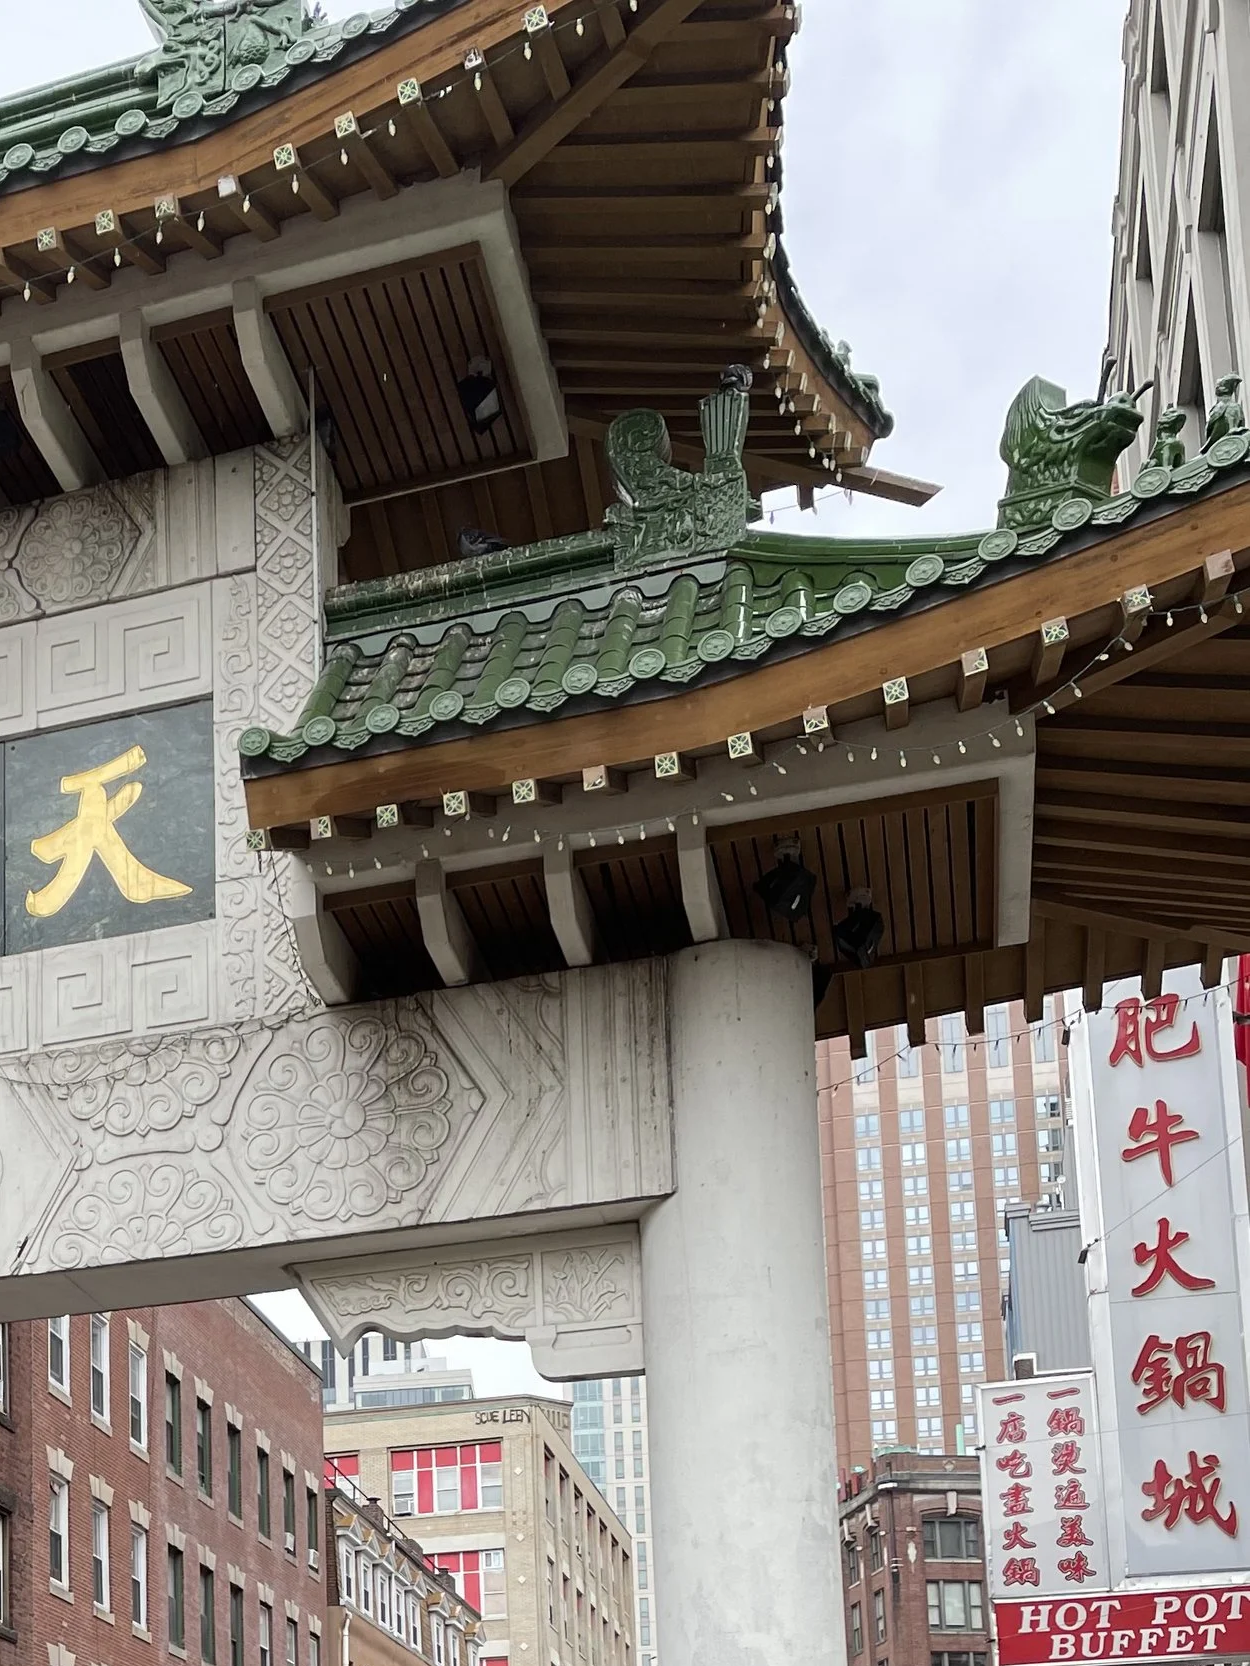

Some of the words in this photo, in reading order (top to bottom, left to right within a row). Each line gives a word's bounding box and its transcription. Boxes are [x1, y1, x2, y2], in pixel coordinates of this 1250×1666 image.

[1109, 993, 1238, 1540] 肥牛火鍋城
[992, 1392, 1040, 1587] 一店吃盡火鍋
[1018, 1600, 1121, 1633] HOT
[1151, 1591, 1250, 1625] POT
[1049, 1623, 1226, 1660] BUFFET
